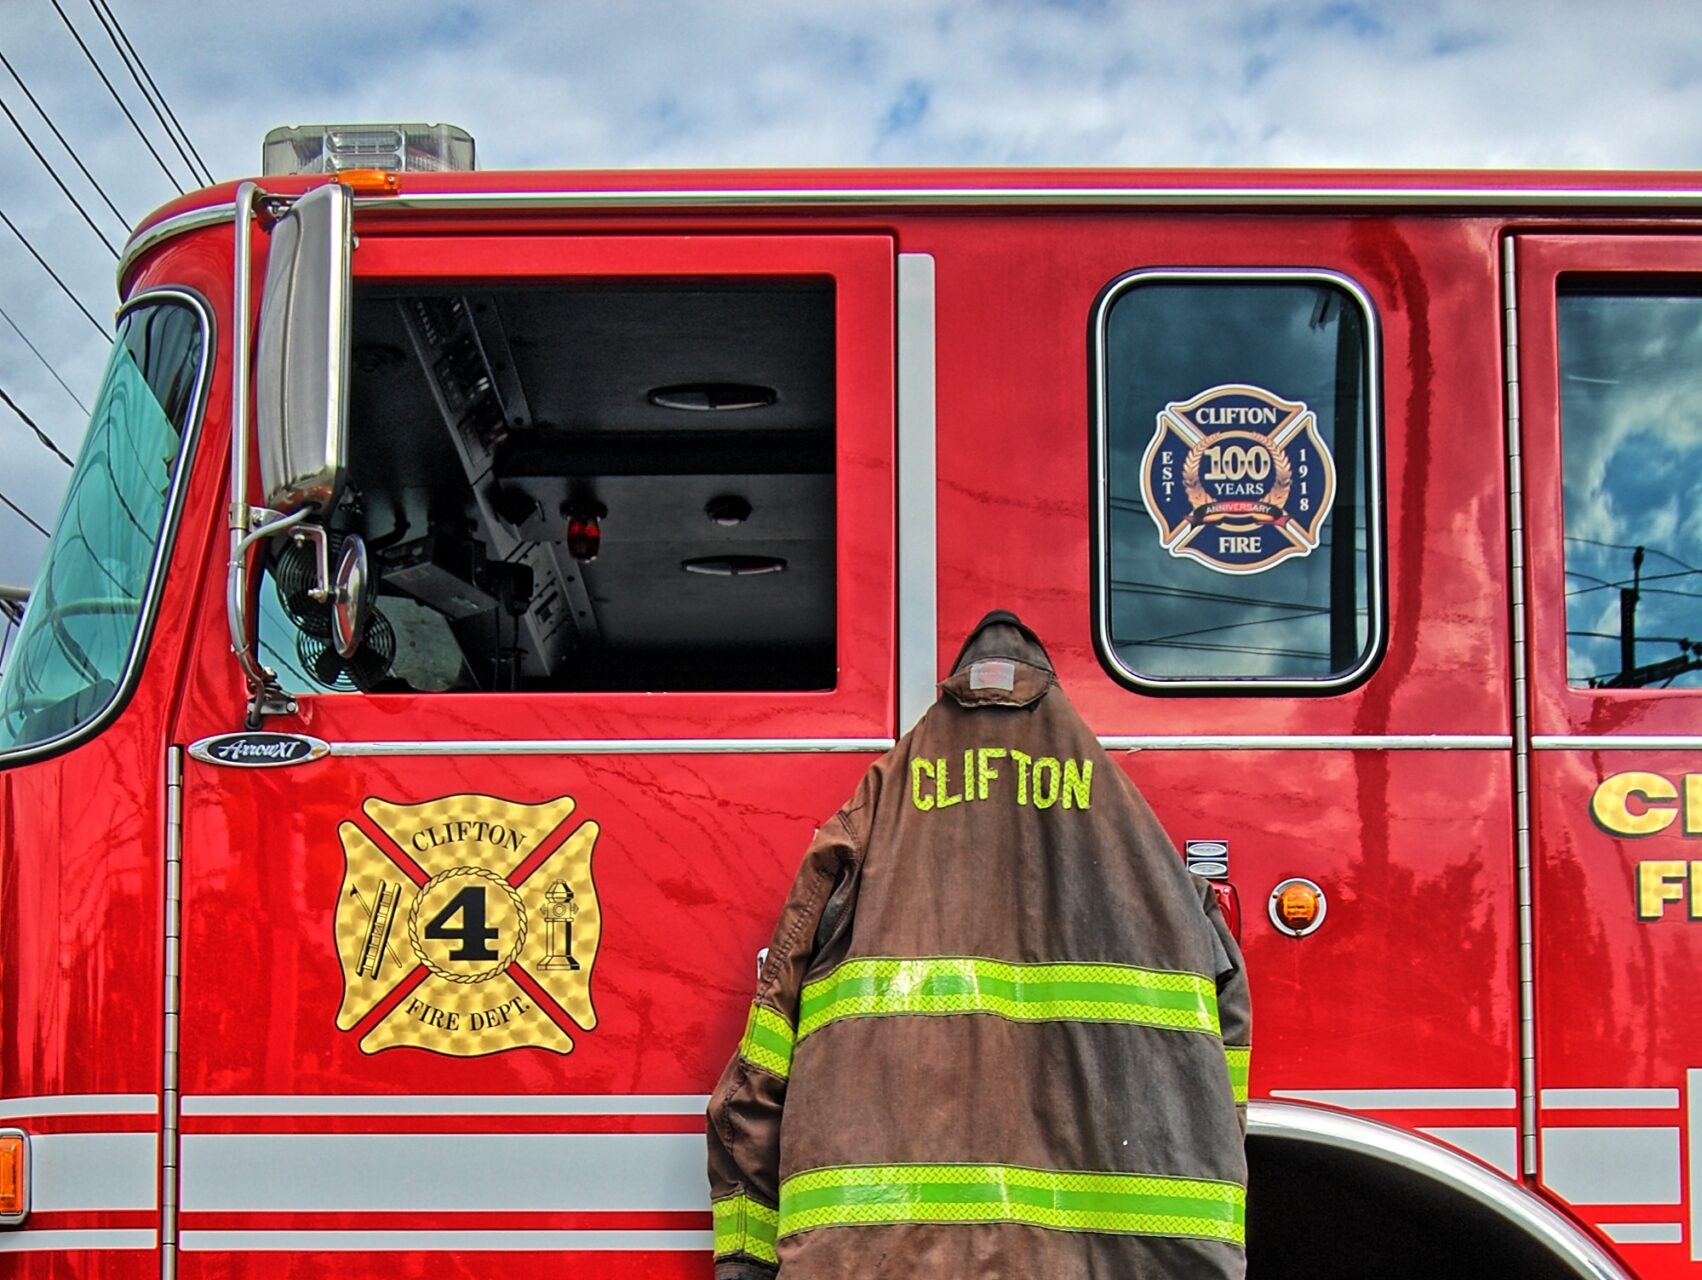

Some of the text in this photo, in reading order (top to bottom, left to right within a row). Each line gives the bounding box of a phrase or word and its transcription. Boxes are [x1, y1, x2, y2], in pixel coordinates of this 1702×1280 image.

[1195, 407, 1277, 425] CLIFTON
[1204, 445, 1271, 481] 100
[1299, 449, 1309, 511] 1918
[1214, 483, 1264, 495] YEARS
[1205, 500, 1272, 514] ANNIVERSARY
[1219, 536, 1262, 553] FIRE
[911, 747, 1094, 812] CLIFTON
[411, 821, 528, 853] CLIFTON
[424, 886, 499, 961] 4
[405, 995, 531, 1031] FIRE DEPT.
